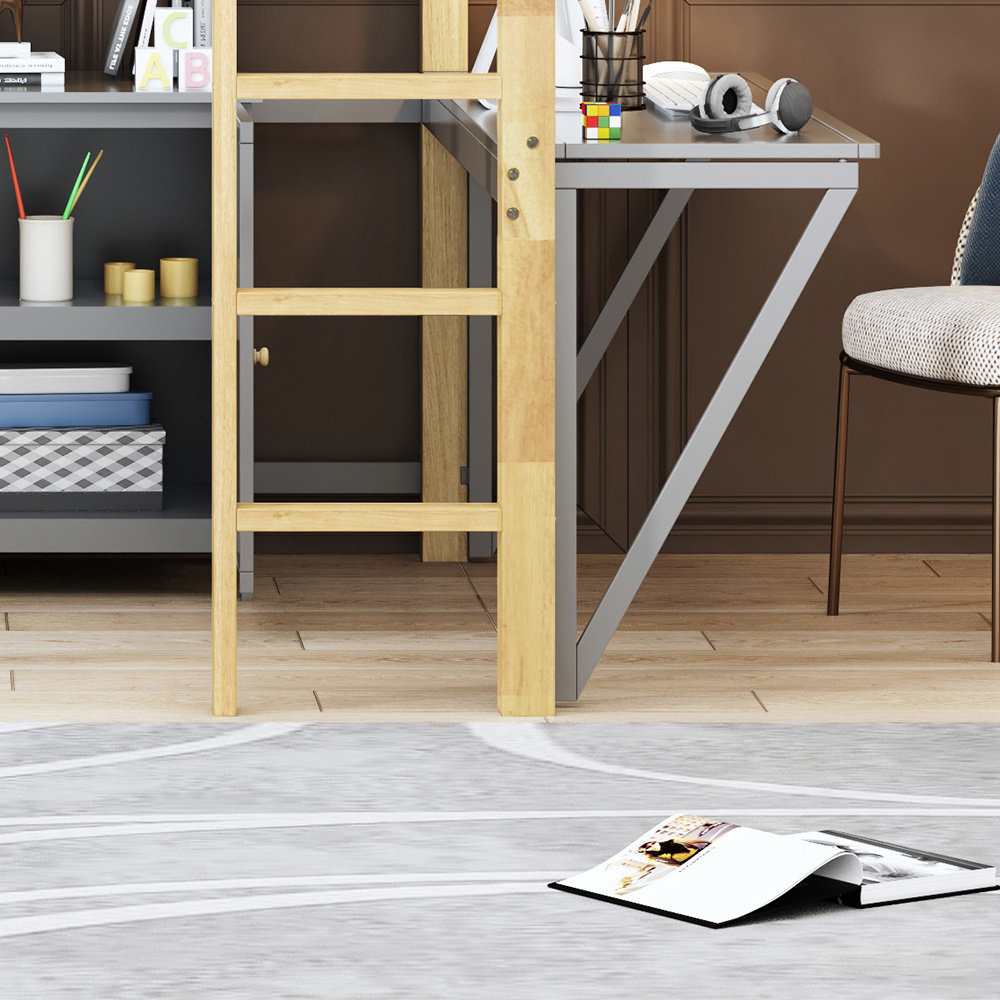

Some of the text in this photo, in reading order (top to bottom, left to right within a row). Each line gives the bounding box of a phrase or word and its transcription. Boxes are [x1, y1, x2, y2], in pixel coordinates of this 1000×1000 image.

[162, 11, 187, 49] C
[139, 52, 210, 89] A B
